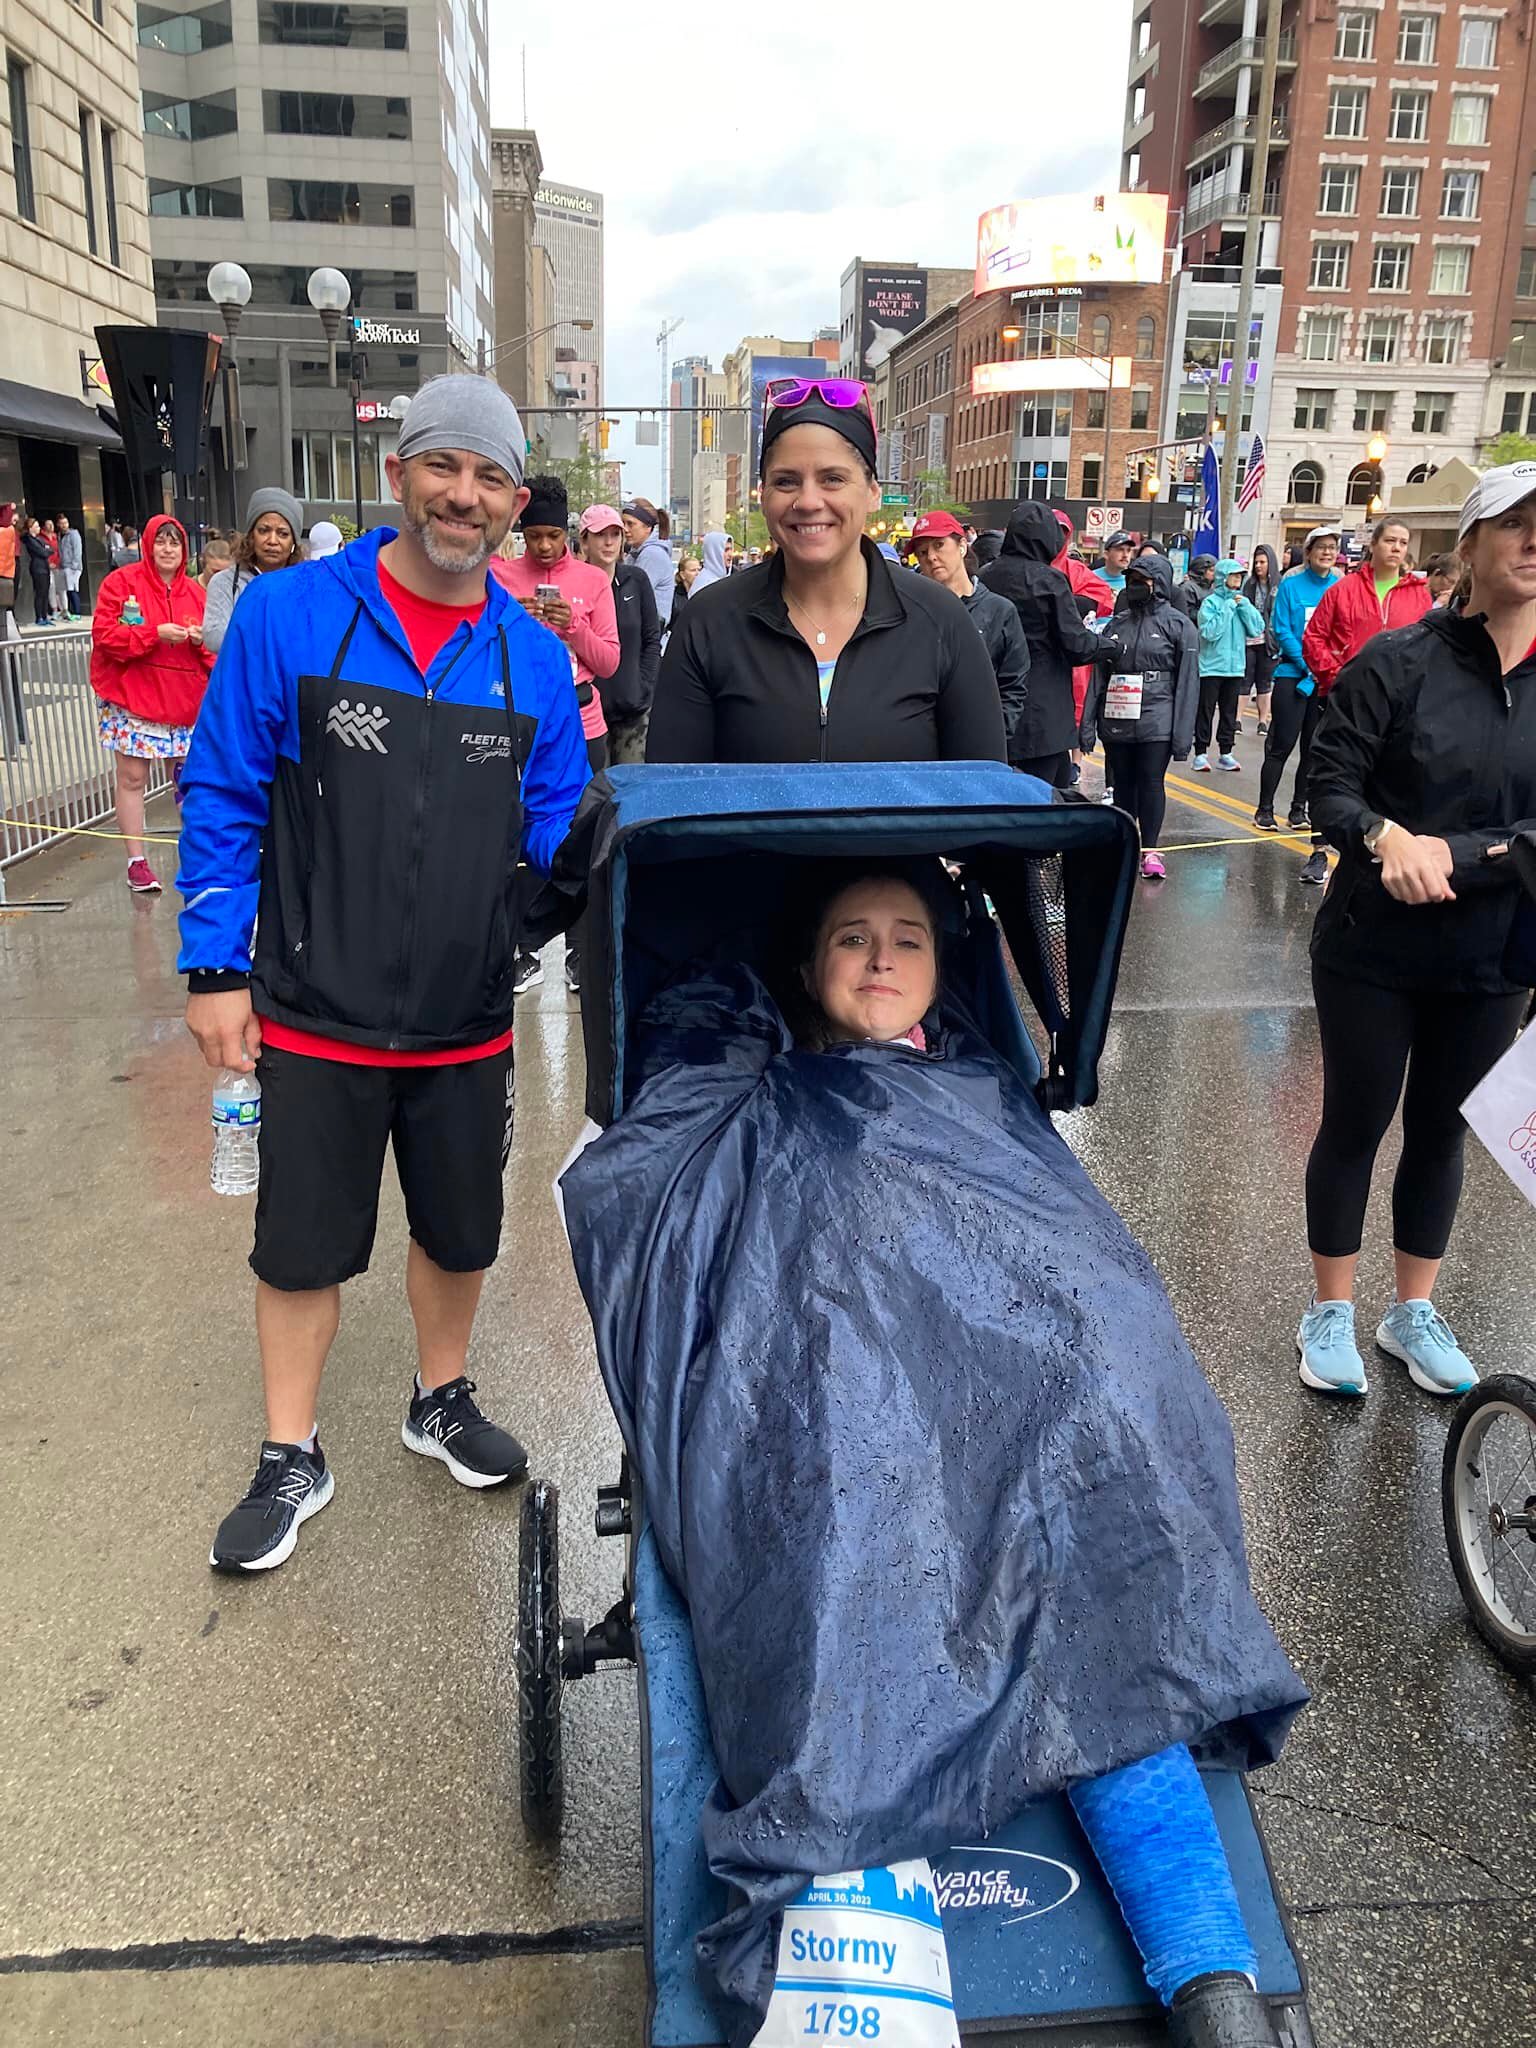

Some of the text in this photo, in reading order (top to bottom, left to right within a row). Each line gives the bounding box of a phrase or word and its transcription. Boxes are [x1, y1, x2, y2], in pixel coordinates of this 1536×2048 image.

[876, 291, 913, 301] PLEASE
[1029, 288, 1054, 297] BARREL
[1057, 287, 1083, 295] MEDIA
[868, 299, 921, 310] DON'T BUY
[360, 318, 389, 333] Frost
[460, 733, 511, 747] FLEET FE
[932, 1869, 1010, 1890] vance
[807, 1892, 872, 1905] APRIL 30, 2022
[790, 1928, 897, 1975] Stormy
[803, 2002, 881, 2039] 1798
